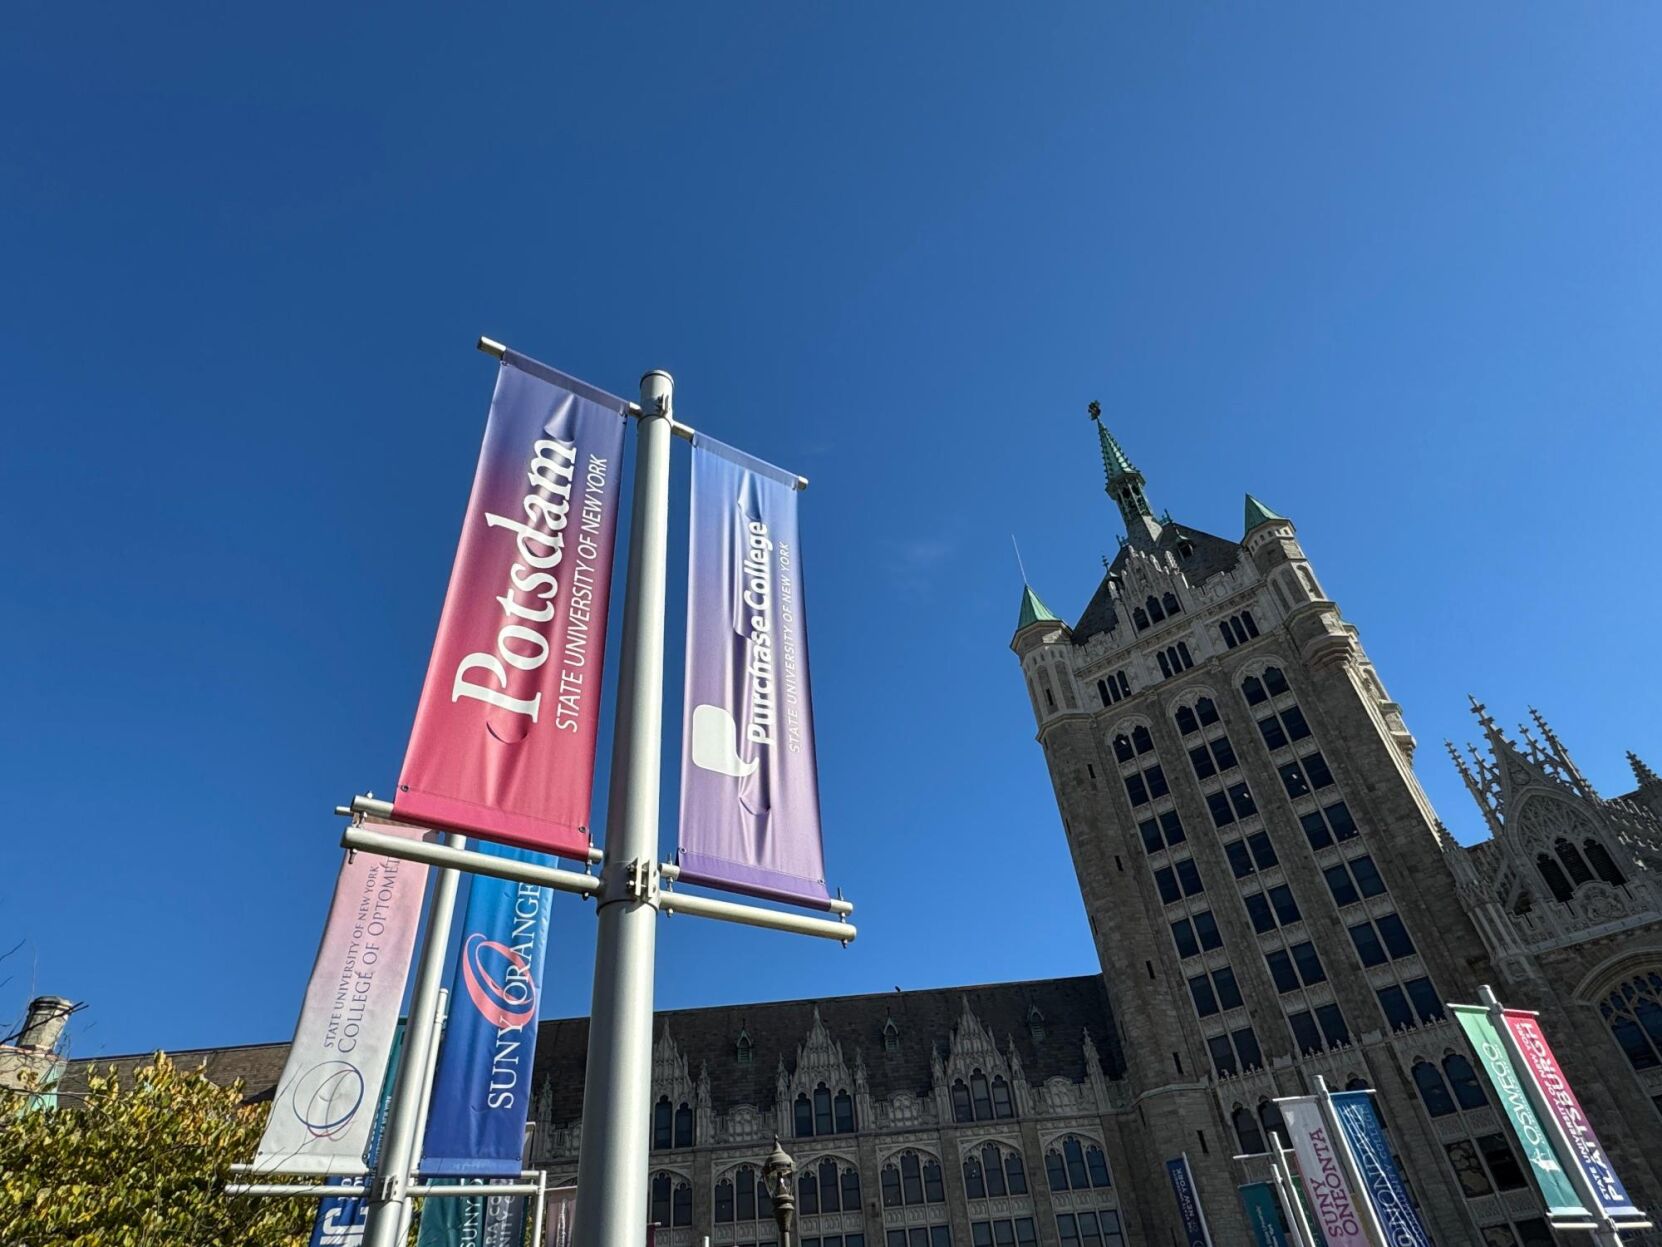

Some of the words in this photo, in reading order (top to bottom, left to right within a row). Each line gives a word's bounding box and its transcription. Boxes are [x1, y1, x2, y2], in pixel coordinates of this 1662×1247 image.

[586, 453, 608, 494] YORK
[581, 494, 603, 535] NEW
[577, 534, 598, 560] OF
[744, 521, 773, 611] College
[779, 541, 790, 572] YORK
[451, 438, 578, 724] Potsdam
[780, 575, 792, 604] NEW
[564, 560, 597, 667] UNIVERSITY
[782, 604, 793, 622] OF
[747, 616, 775, 745] Purchase
[783, 624, 798, 704] UNIVERSITY
[555, 669, 583, 733] STATE
[788, 709, 800, 753] STATE
[364, 865, 380, 893] YORK
[367, 857, 401, 937] OPTOMET
[358, 896, 371, 920] NEW
[352, 923, 364, 939] OF
[505, 882, 541, 1005] ORANGE
[338, 941, 361, 1010] UNIVERSITY
[362, 943, 380, 967] OF
[324, 1013, 342, 1048] STATE
[337, 969, 373, 1054] COLLEGE
[1514, 1023, 1532, 1050] YORK
[487, 1015, 524, 1110] SUNY
[1530, 1053, 1546, 1078] NEW
[1483, 1042, 1540, 1145] OSWEGO
[1544, 1080, 1556, 1096] OF
[1521, 1022, 1624, 1201] PLATTSBURGH
[1554, 1098, 1591, 1163] UNIVERSITY
[1176, 1167, 1186, 1192] YORK
[1308, 1128, 1359, 1237] ONEONTA
[1589, 1166, 1609, 1199] STATE
[1183, 1195, 1194, 1217] NEW
[1311, 1178, 1344, 1238] SUNY
